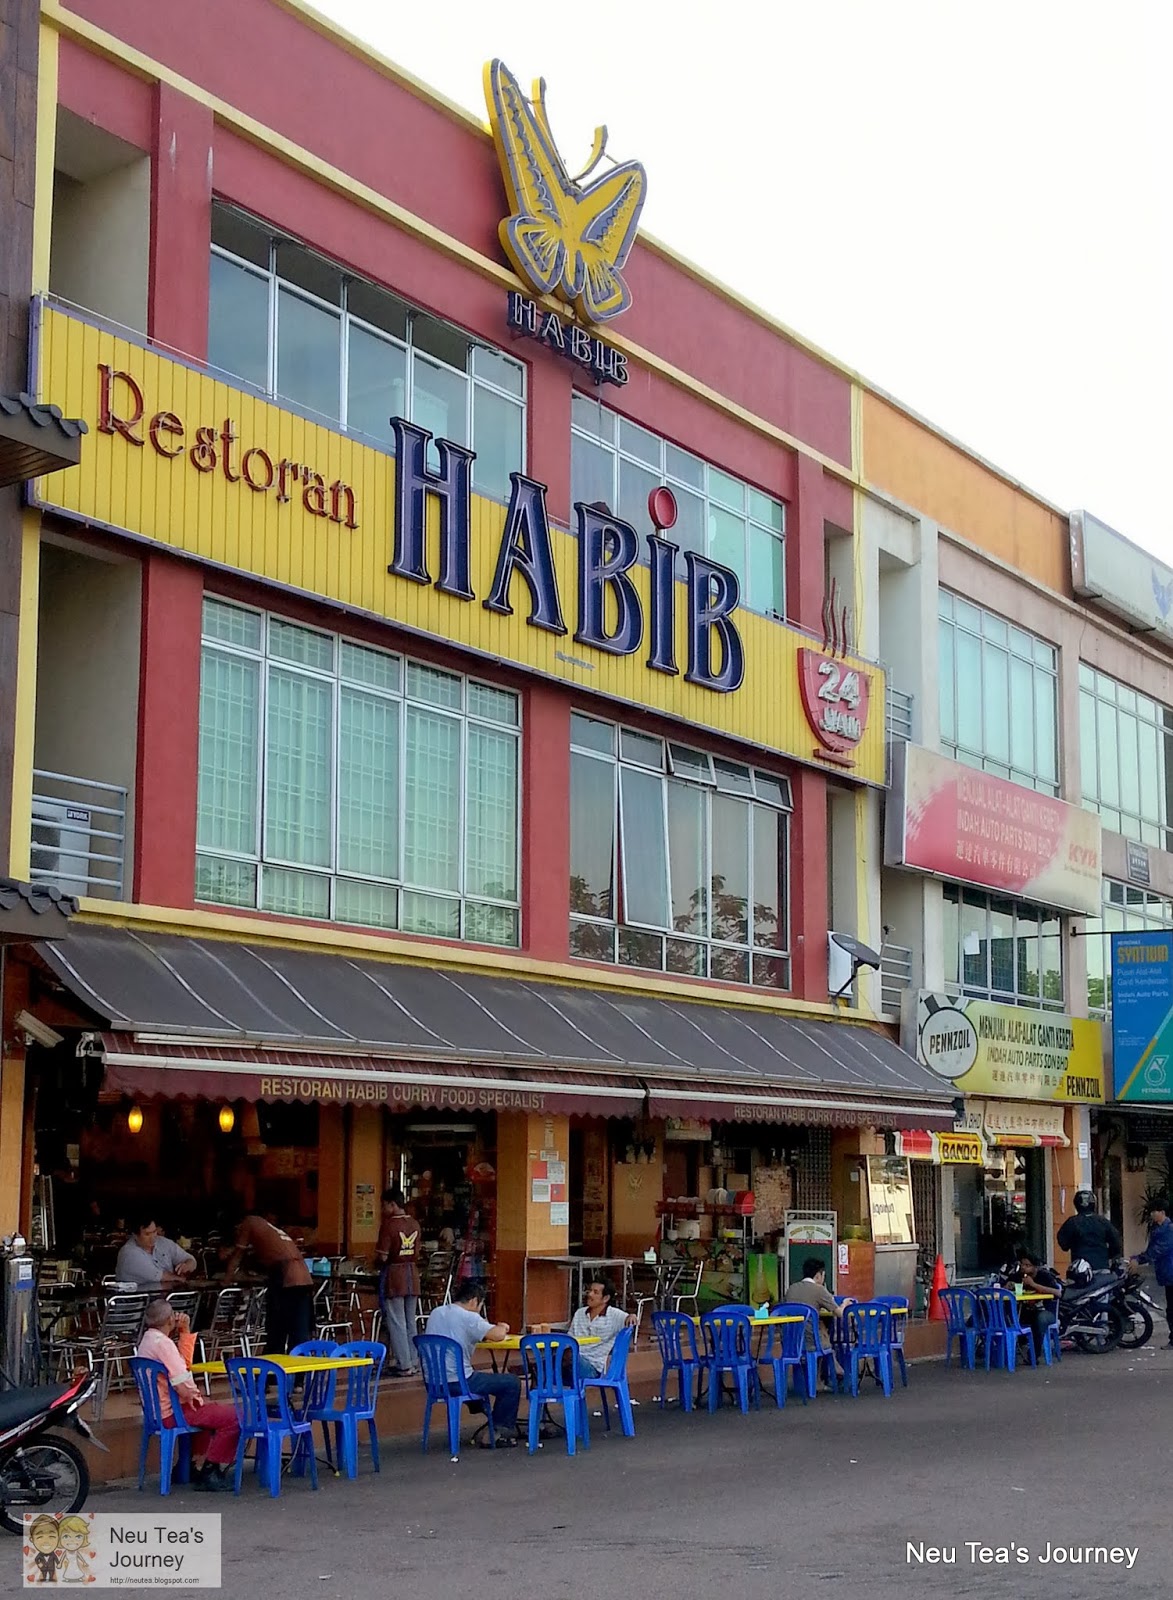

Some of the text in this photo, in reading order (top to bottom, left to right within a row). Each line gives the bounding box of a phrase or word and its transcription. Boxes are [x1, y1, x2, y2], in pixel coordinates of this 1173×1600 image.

[507, 290, 629, 387] HABIB
[97, 364, 360, 529] Restoran
[818, 662, 861, 710] 24
[930, 1029, 970, 1055] PENNZOIL
[987, 1047, 1068, 1071] INDAH AUTO PARTS SDN BHD
[261, 1078, 546, 1109] RESTORAN HABIB CURRY FOOD SPECIALIST
[1066, 1075, 1101, 1098] PENNZOIL
[734, 1105, 781, 1120] RESTORAN
[807, 1109, 833, 1123] CURRY
[835, 1111, 857, 1124] FOOD
[857, 1112, 898, 1126] SPECIALIST
[968, 1113, 981, 1128] BHD
[942, 1142, 979, 1160] BANDO
